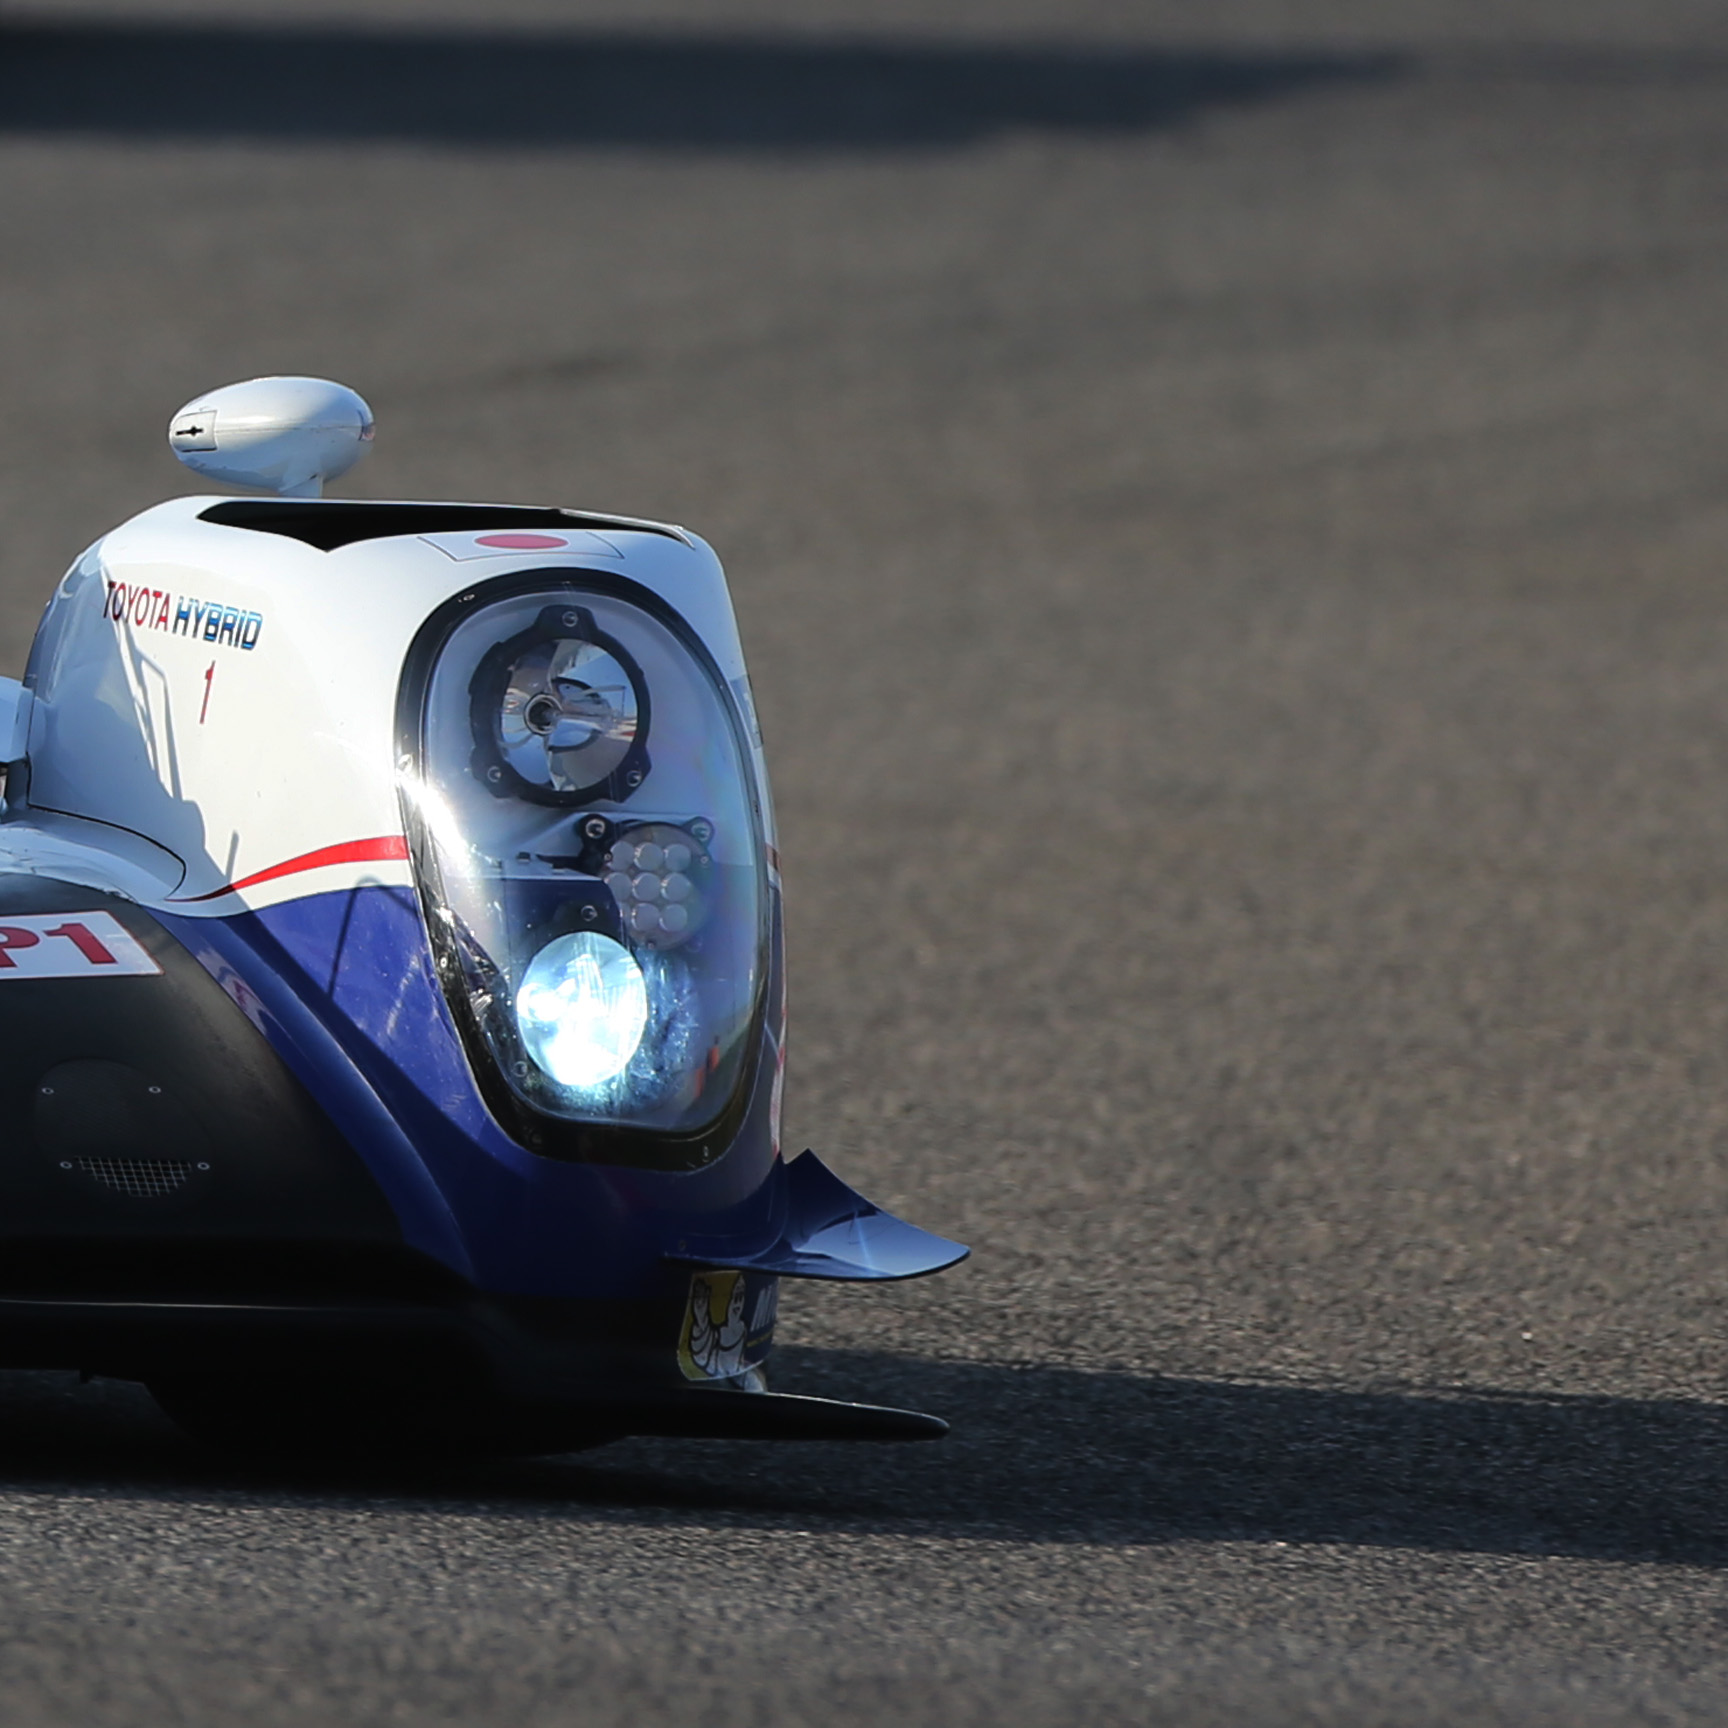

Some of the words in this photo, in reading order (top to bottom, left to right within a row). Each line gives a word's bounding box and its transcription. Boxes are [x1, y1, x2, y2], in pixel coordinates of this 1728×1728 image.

[103, 580, 171, 632] TOYOTA
[171, 595, 263, 651] HYBRID
[199, 660, 216, 725] 1
